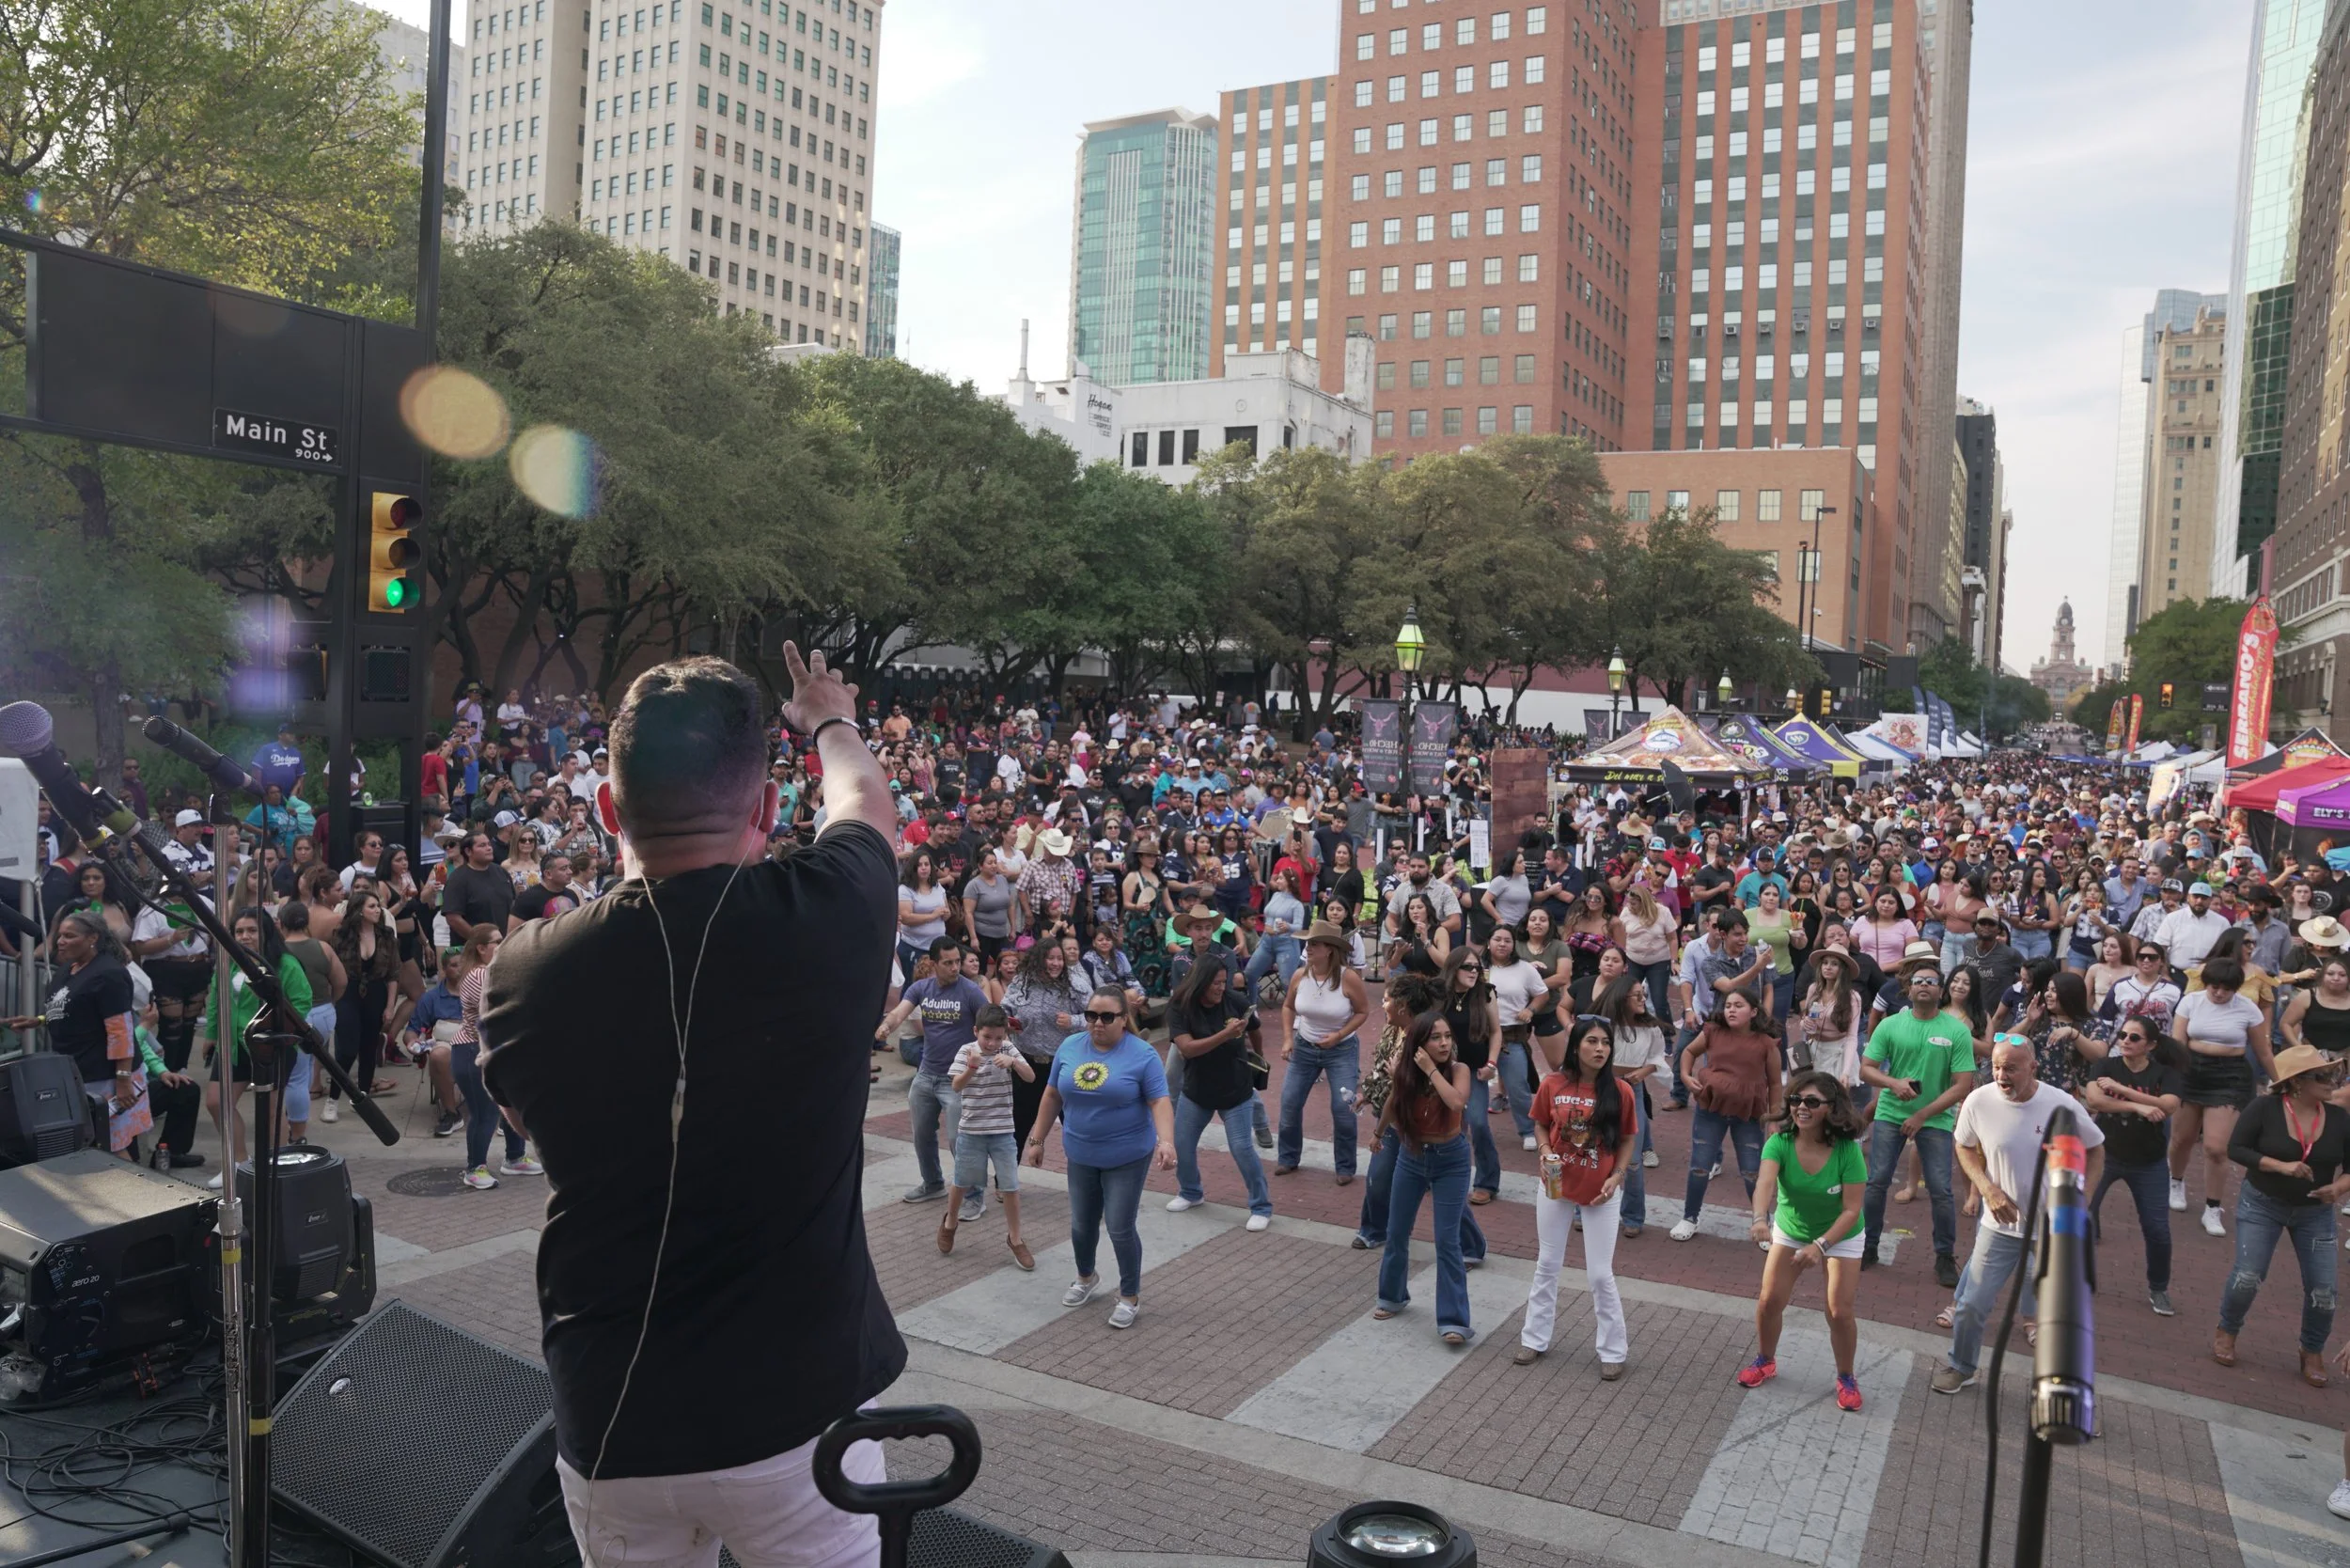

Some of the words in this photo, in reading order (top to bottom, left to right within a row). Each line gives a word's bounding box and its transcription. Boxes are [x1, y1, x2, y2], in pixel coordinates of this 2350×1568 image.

[226, 415, 287, 444] Main
[301, 428, 327, 450] St
[294, 448, 321, 461] 900
[2233, 632, 2260, 760] SERRANO'S
[271, 754, 300, 766] Dodgers
[1604, 771, 1622, 780] Del
[2313, 808, 2344, 819] ELY'S
[921, 997, 961, 1011] Adulting
[90, 1275, 100, 1283] 20
